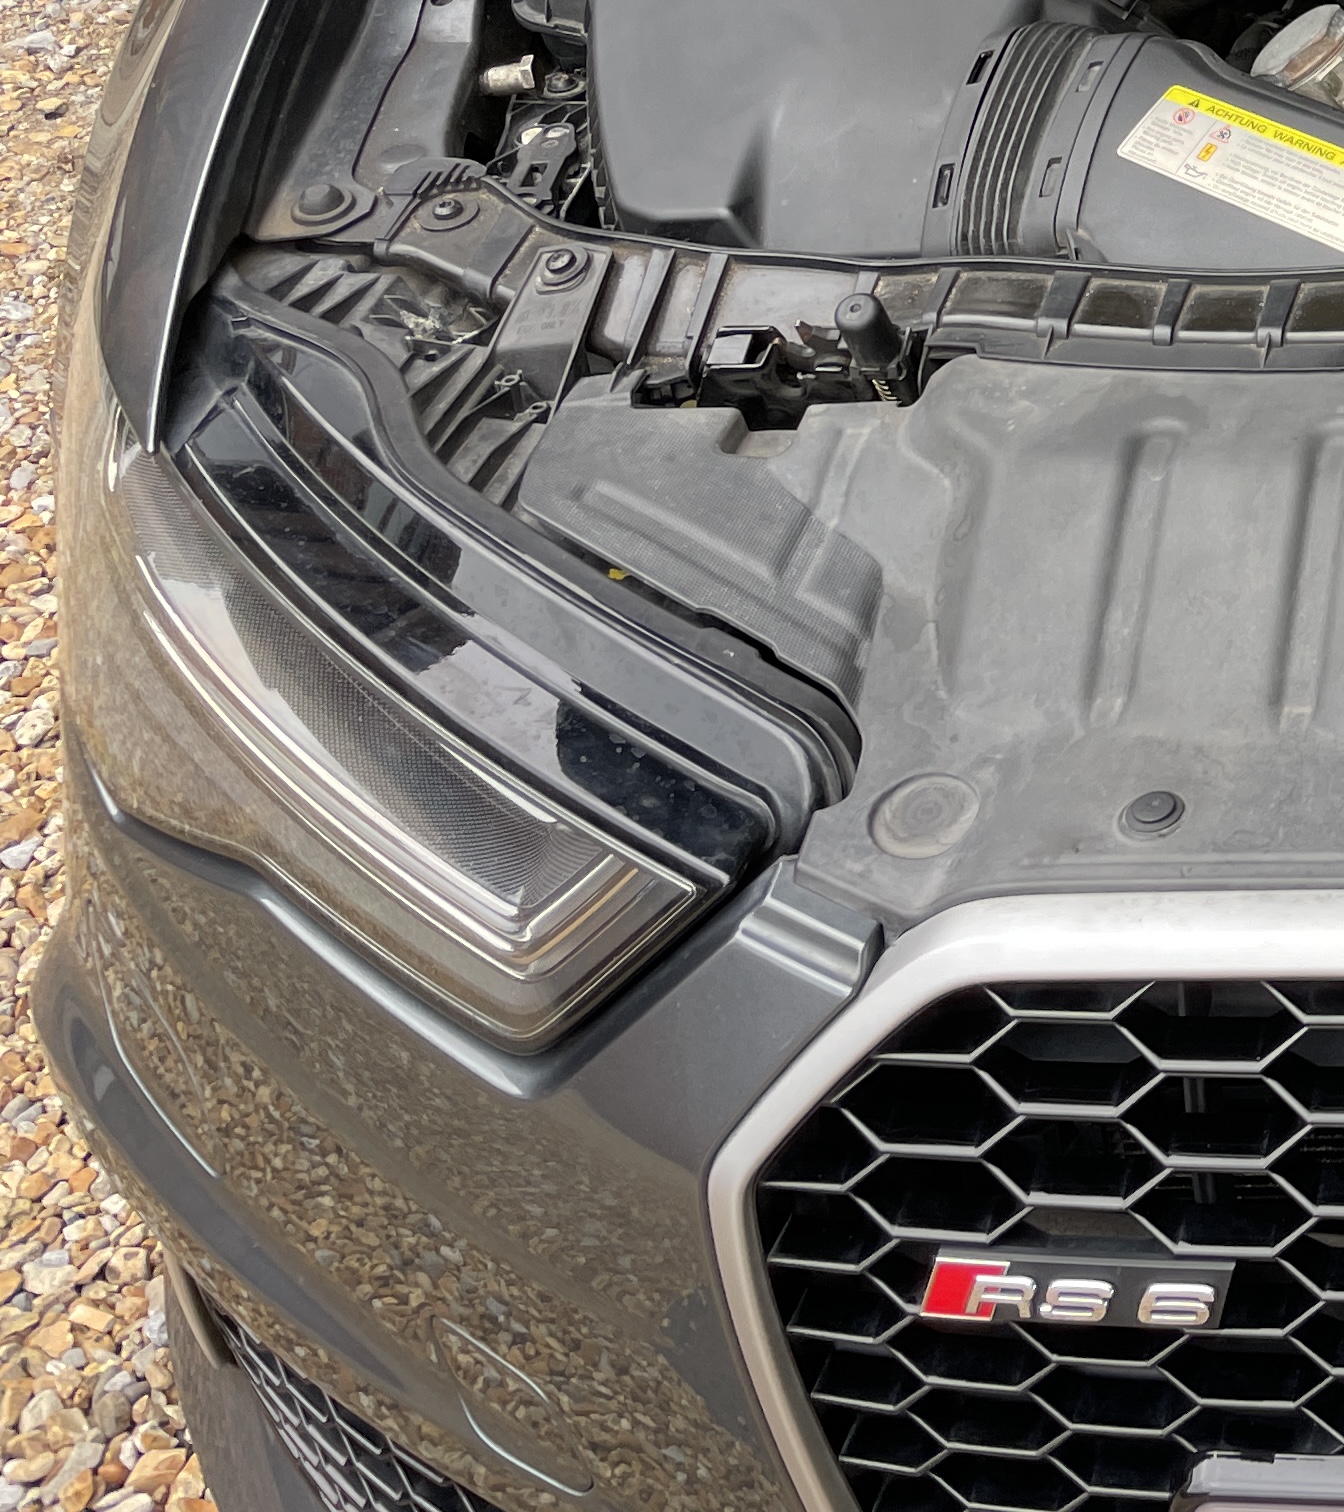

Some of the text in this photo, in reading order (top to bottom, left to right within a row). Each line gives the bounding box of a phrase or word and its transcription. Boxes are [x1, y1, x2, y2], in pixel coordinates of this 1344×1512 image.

[1205, 105, 1268, 134] ACHTUNG
[1273, 128, 1336, 161] WARNING
[964, 1274, 1216, 1326] RS 6
